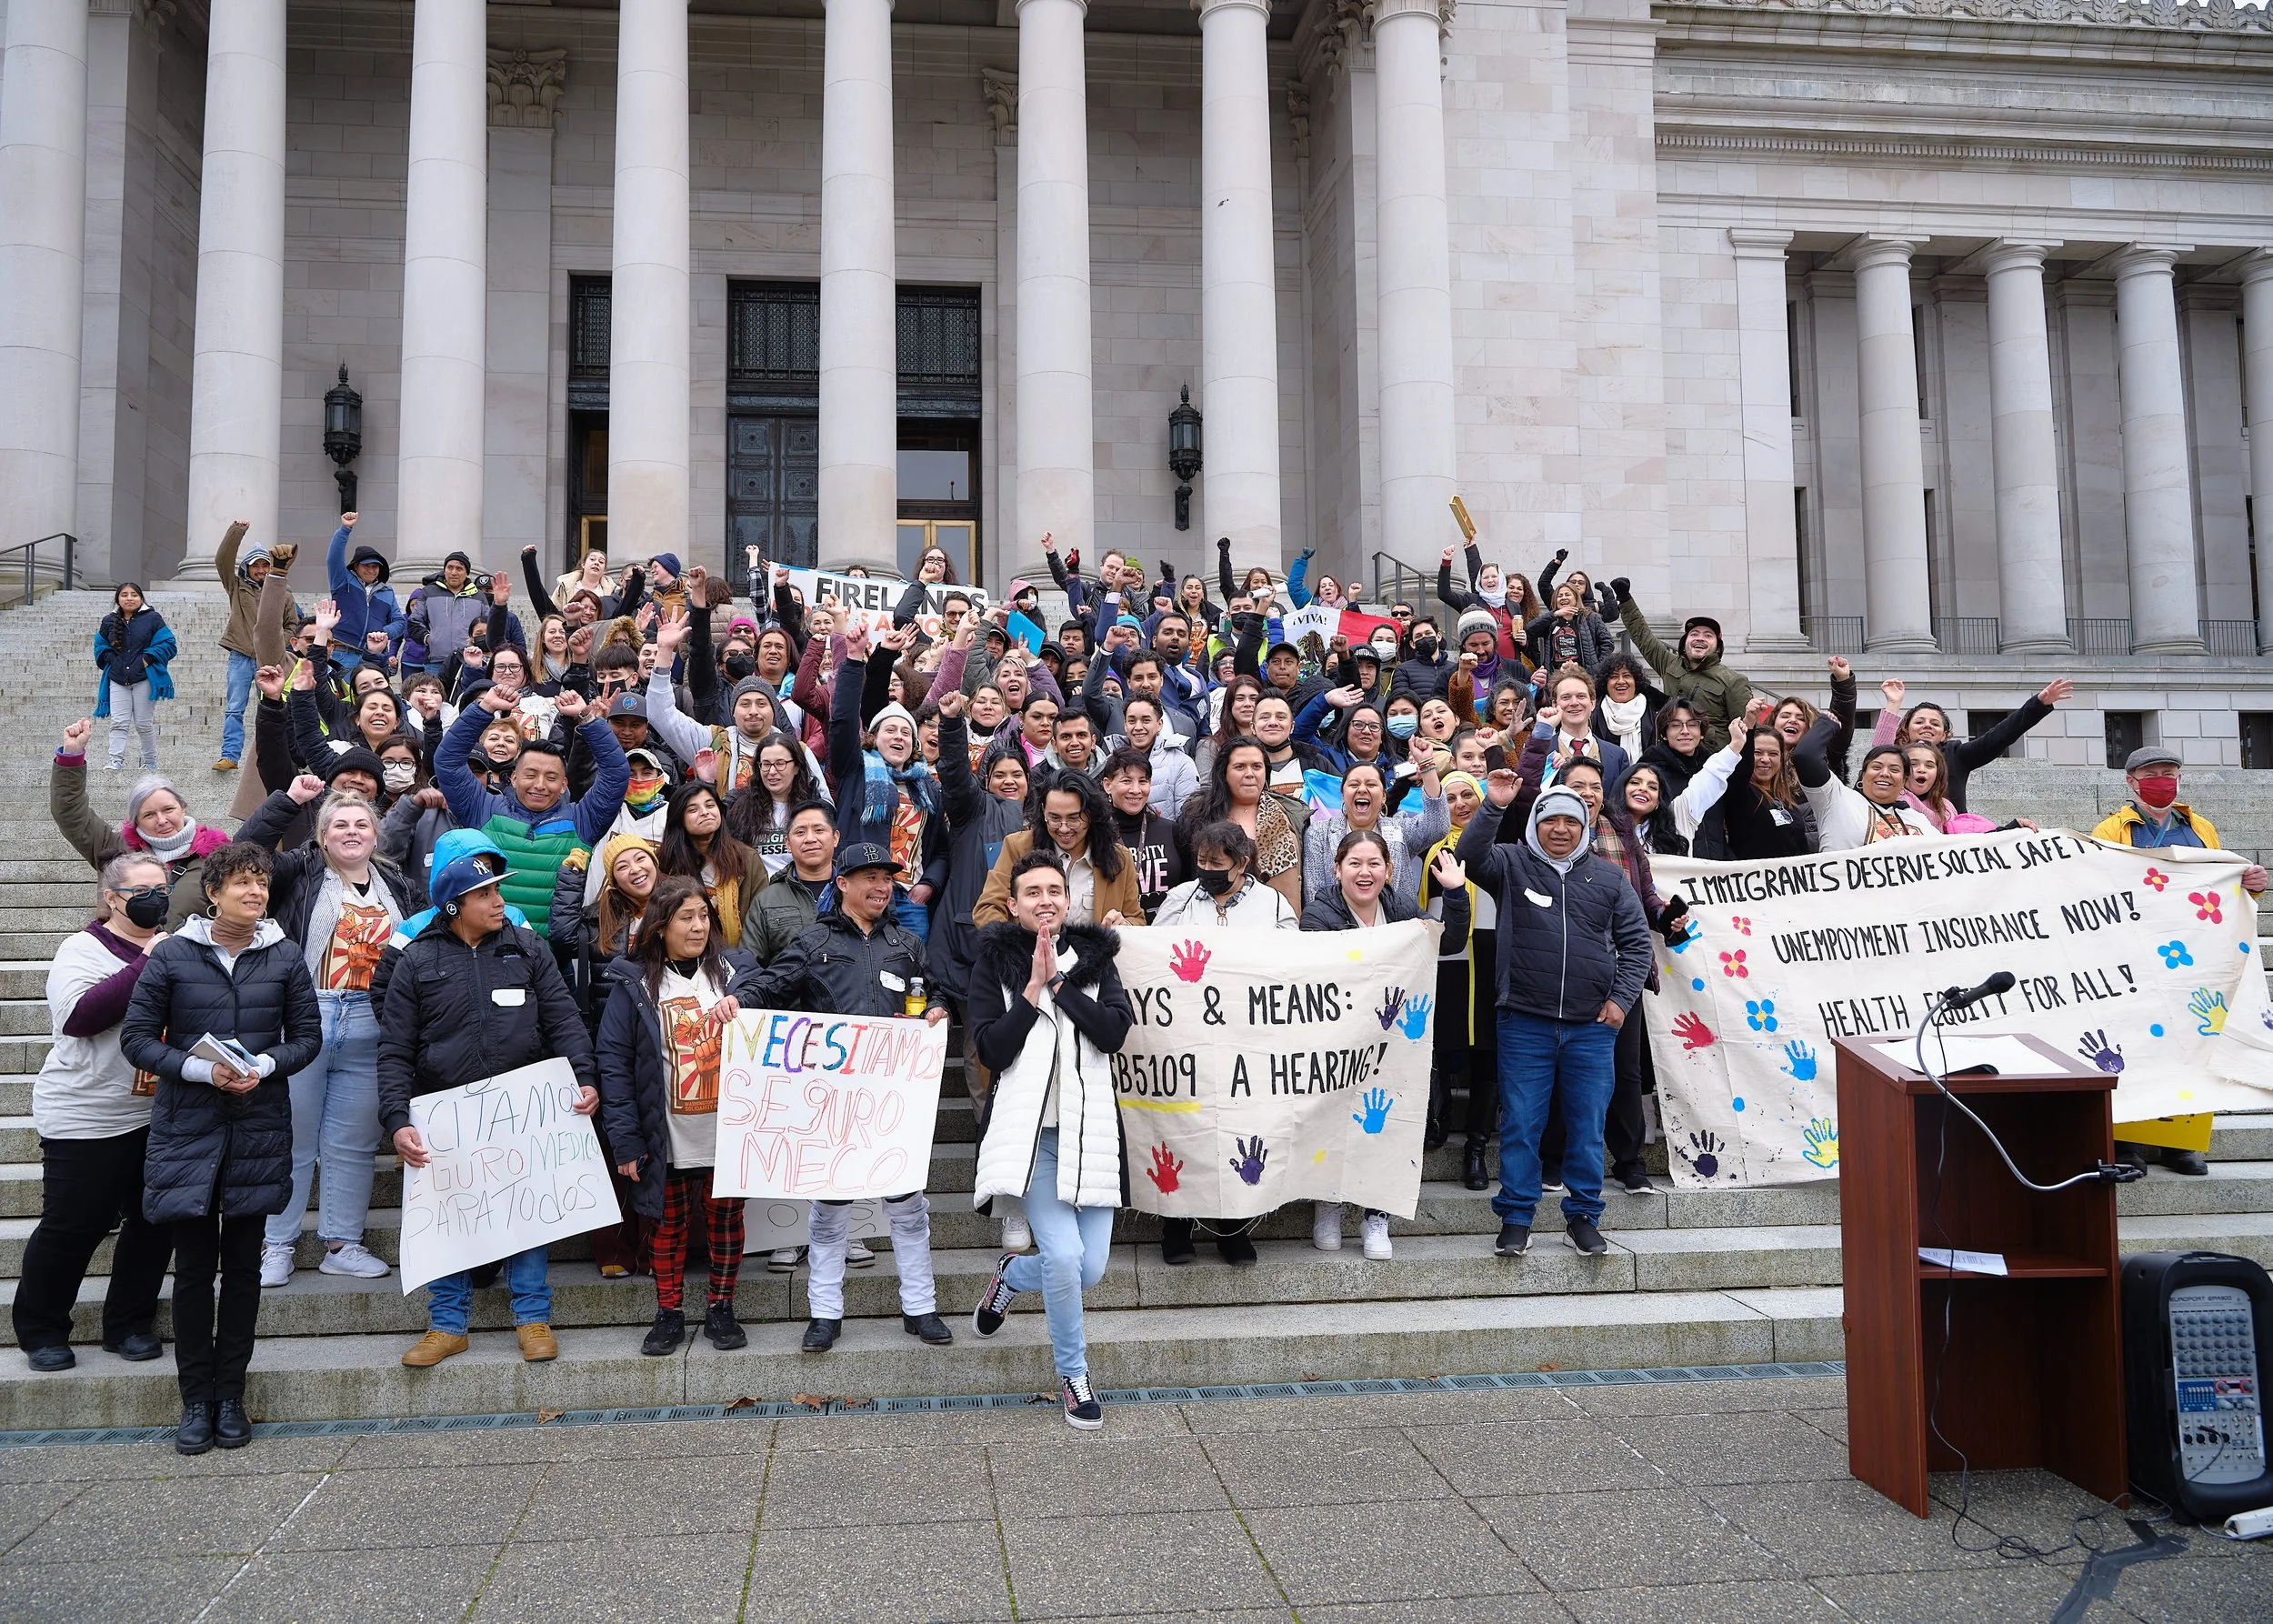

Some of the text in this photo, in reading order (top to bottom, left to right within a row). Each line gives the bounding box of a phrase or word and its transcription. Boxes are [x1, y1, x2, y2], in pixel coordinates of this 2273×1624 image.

[816, 576, 986, 617] FIRELNS
[1293, 613, 1327, 626] ¡VIVA!
[1846, 853, 1939, 890] DESERVE
[1938, 846, 2012, 877] SOCIAL
[1771, 890, 2141, 964] UNEMPOYMENT INSURANCE NOW!
[1203, 986, 1227, 1026] &
[1248, 982, 1353, 1026] MEANS:
[1818, 994, 1910, 1040] HEALTH
[2018, 976, 2068, 1013] FOR
[2071, 964, 2138, 1003] ALL!
[727, 1012, 946, 1082] NECESITAMOS
[1230, 1053, 1251, 1098] A
[1270, 1042, 1388, 1096] HEARING!
[528, 1130, 600, 1178] MEDICO
[740, 1131, 908, 1195] MECO
